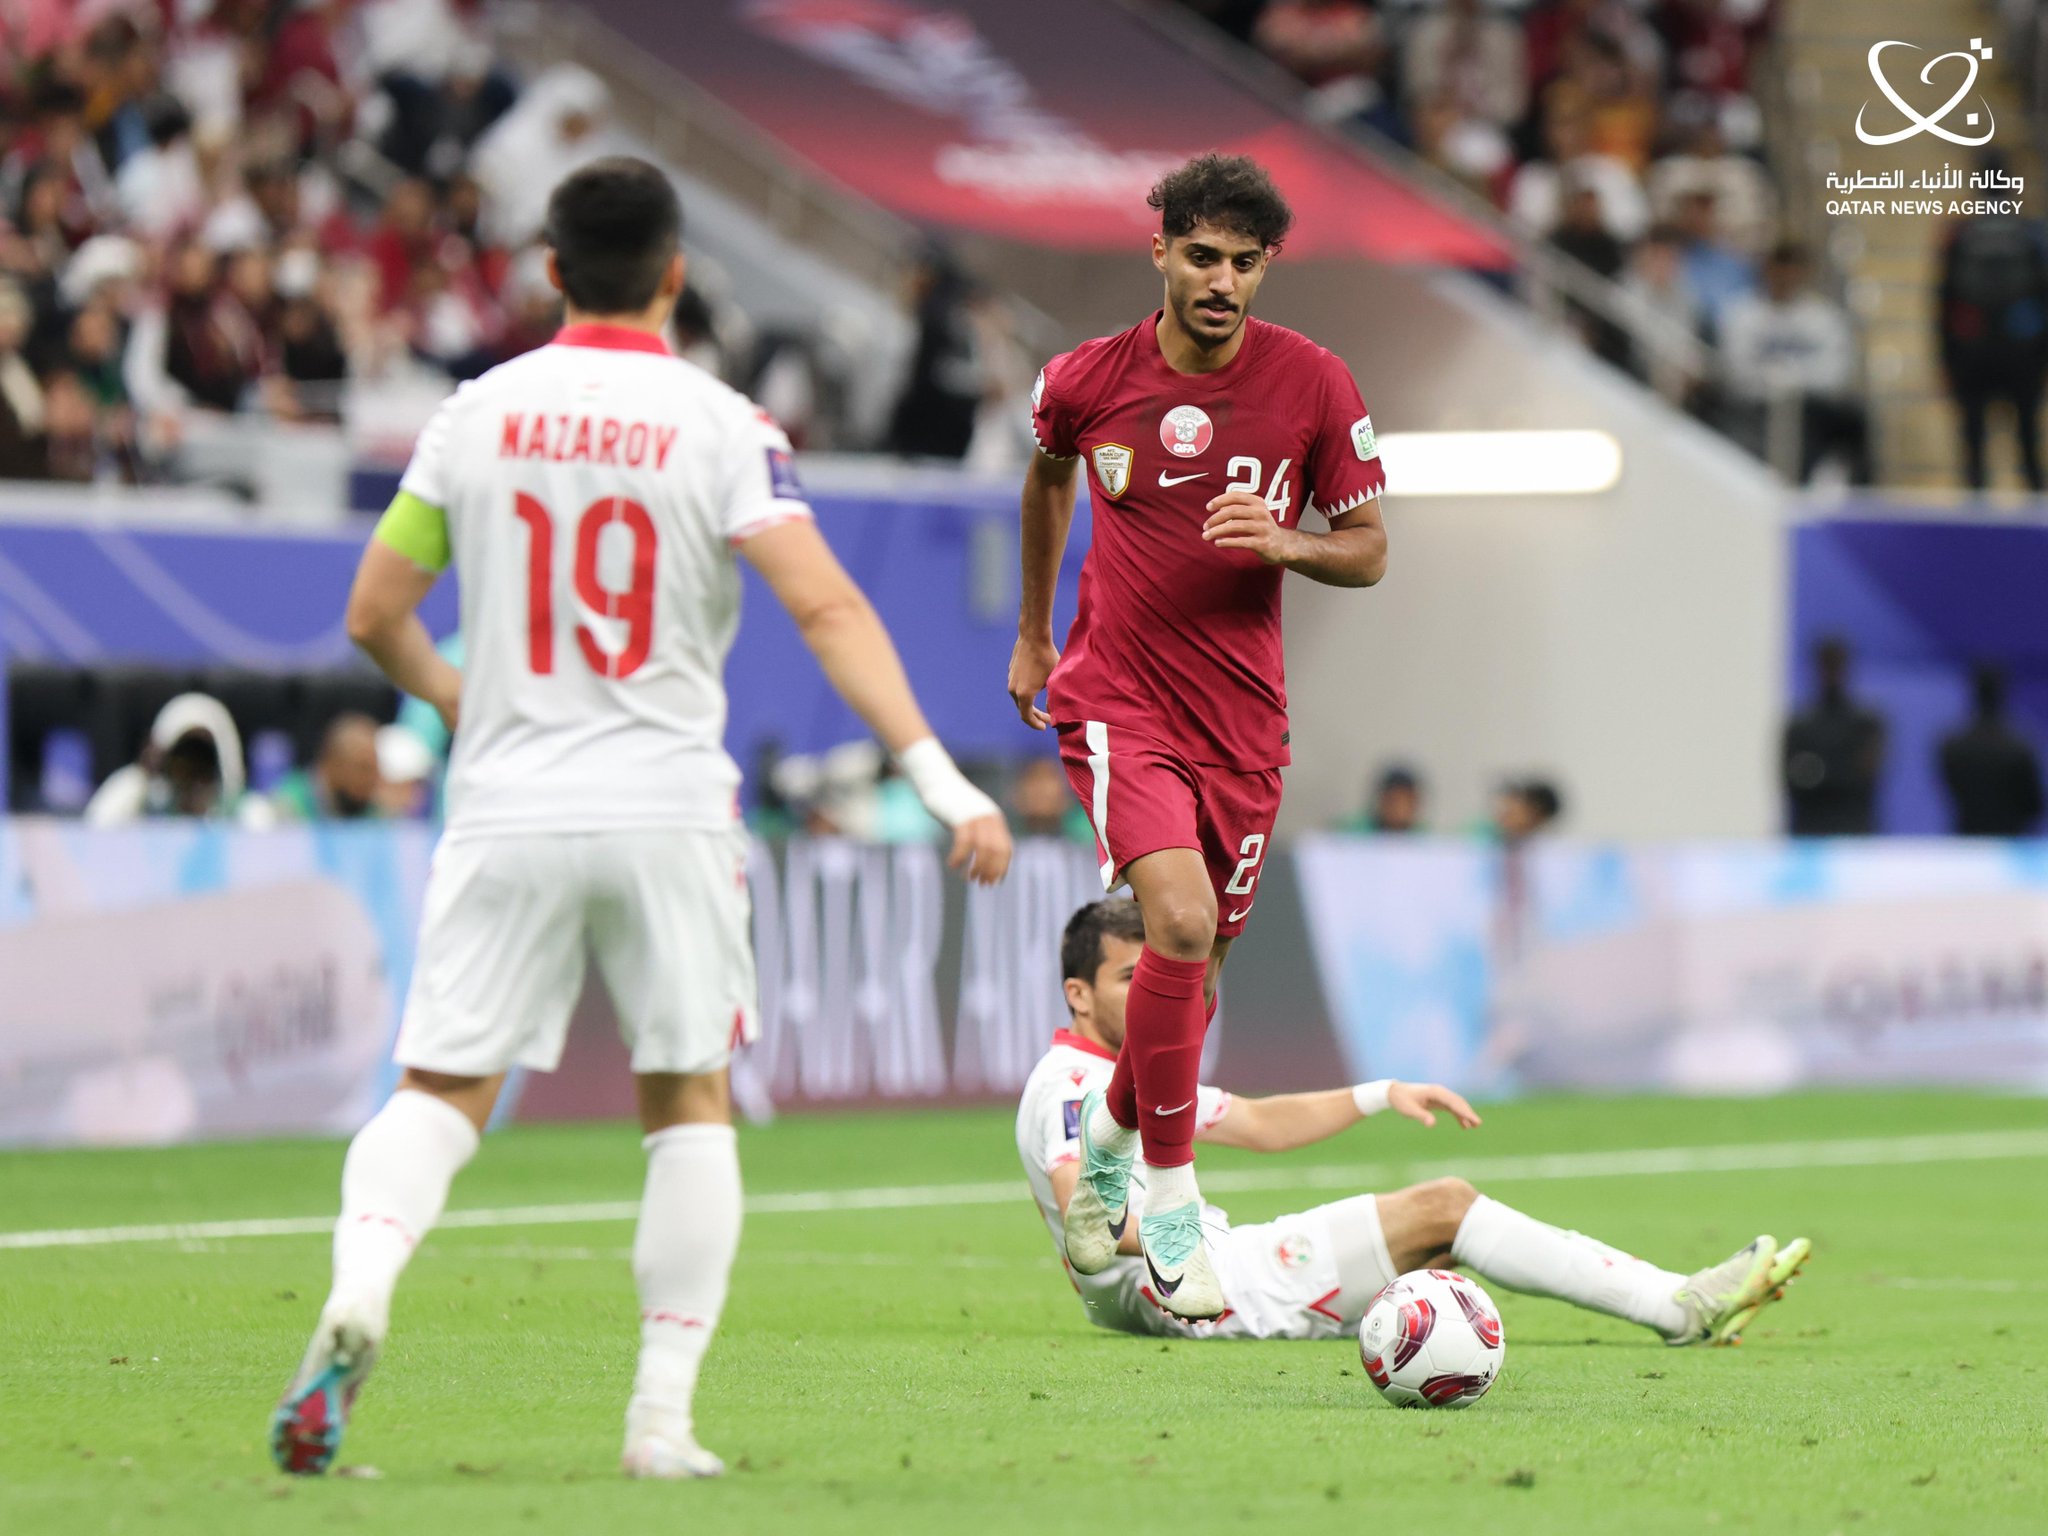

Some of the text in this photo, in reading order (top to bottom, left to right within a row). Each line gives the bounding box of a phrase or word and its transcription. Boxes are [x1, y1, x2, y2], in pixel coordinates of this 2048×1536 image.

[499, 413, 678, 471] NAZAROV
[1358, 423, 1371, 435] AFC
[1225, 456, 1292, 523] 24
[514, 489, 658, 681] 19
[1225, 833, 1265, 895] 2
